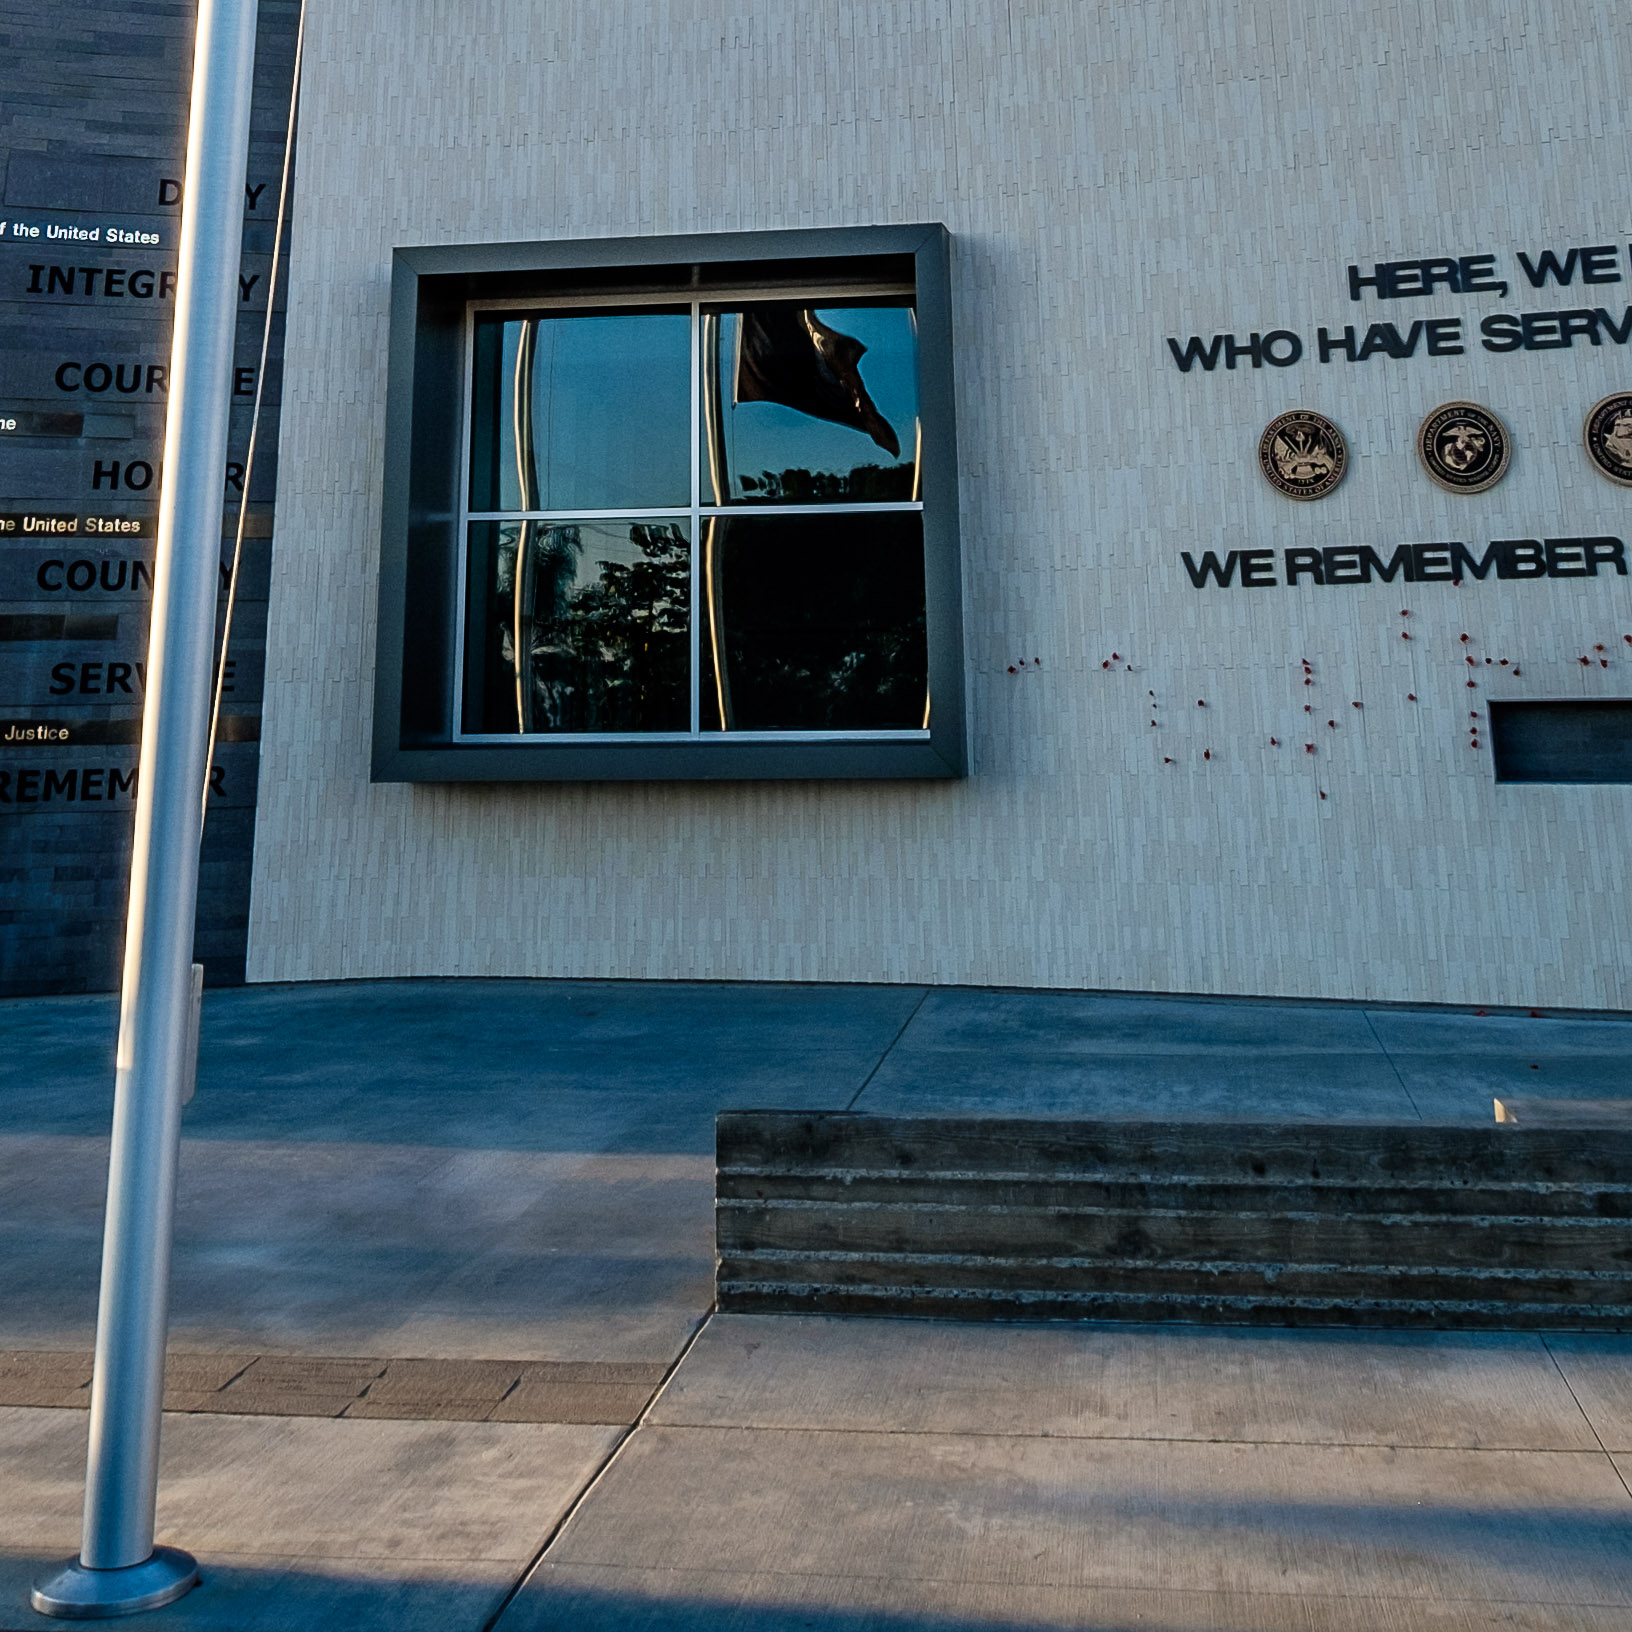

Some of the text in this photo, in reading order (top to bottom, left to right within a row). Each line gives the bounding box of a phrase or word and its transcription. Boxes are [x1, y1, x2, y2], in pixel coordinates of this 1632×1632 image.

[158, 178, 266, 211] DY
[13, 223, 39, 238] the
[47, 225, 99, 241] United
[106, 228, 159, 244] States
[25, 264, 260, 303] INTEGRY
[1348, 252, 1508, 300] HERE,
[1518, 244, 1619, 289] WE
[1167, 329, 1303, 372] WHO
[1317, 318, 1465, 363] HAVE
[54, 362, 256, 397] COURE
[1425, 409, 1466, 451] DEPARTMENT
[1487, 423, 1502, 448] NAVY
[91, 460, 249, 493] HOR
[23, 516, 77, 532] United
[85, 518, 140, 532] States
[36, 559, 242, 592] COUNY
[1181, 550, 1279, 589] WE
[1285, 536, 1629, 588] REMEMBER
[5, 725, 69, 741] Justice
